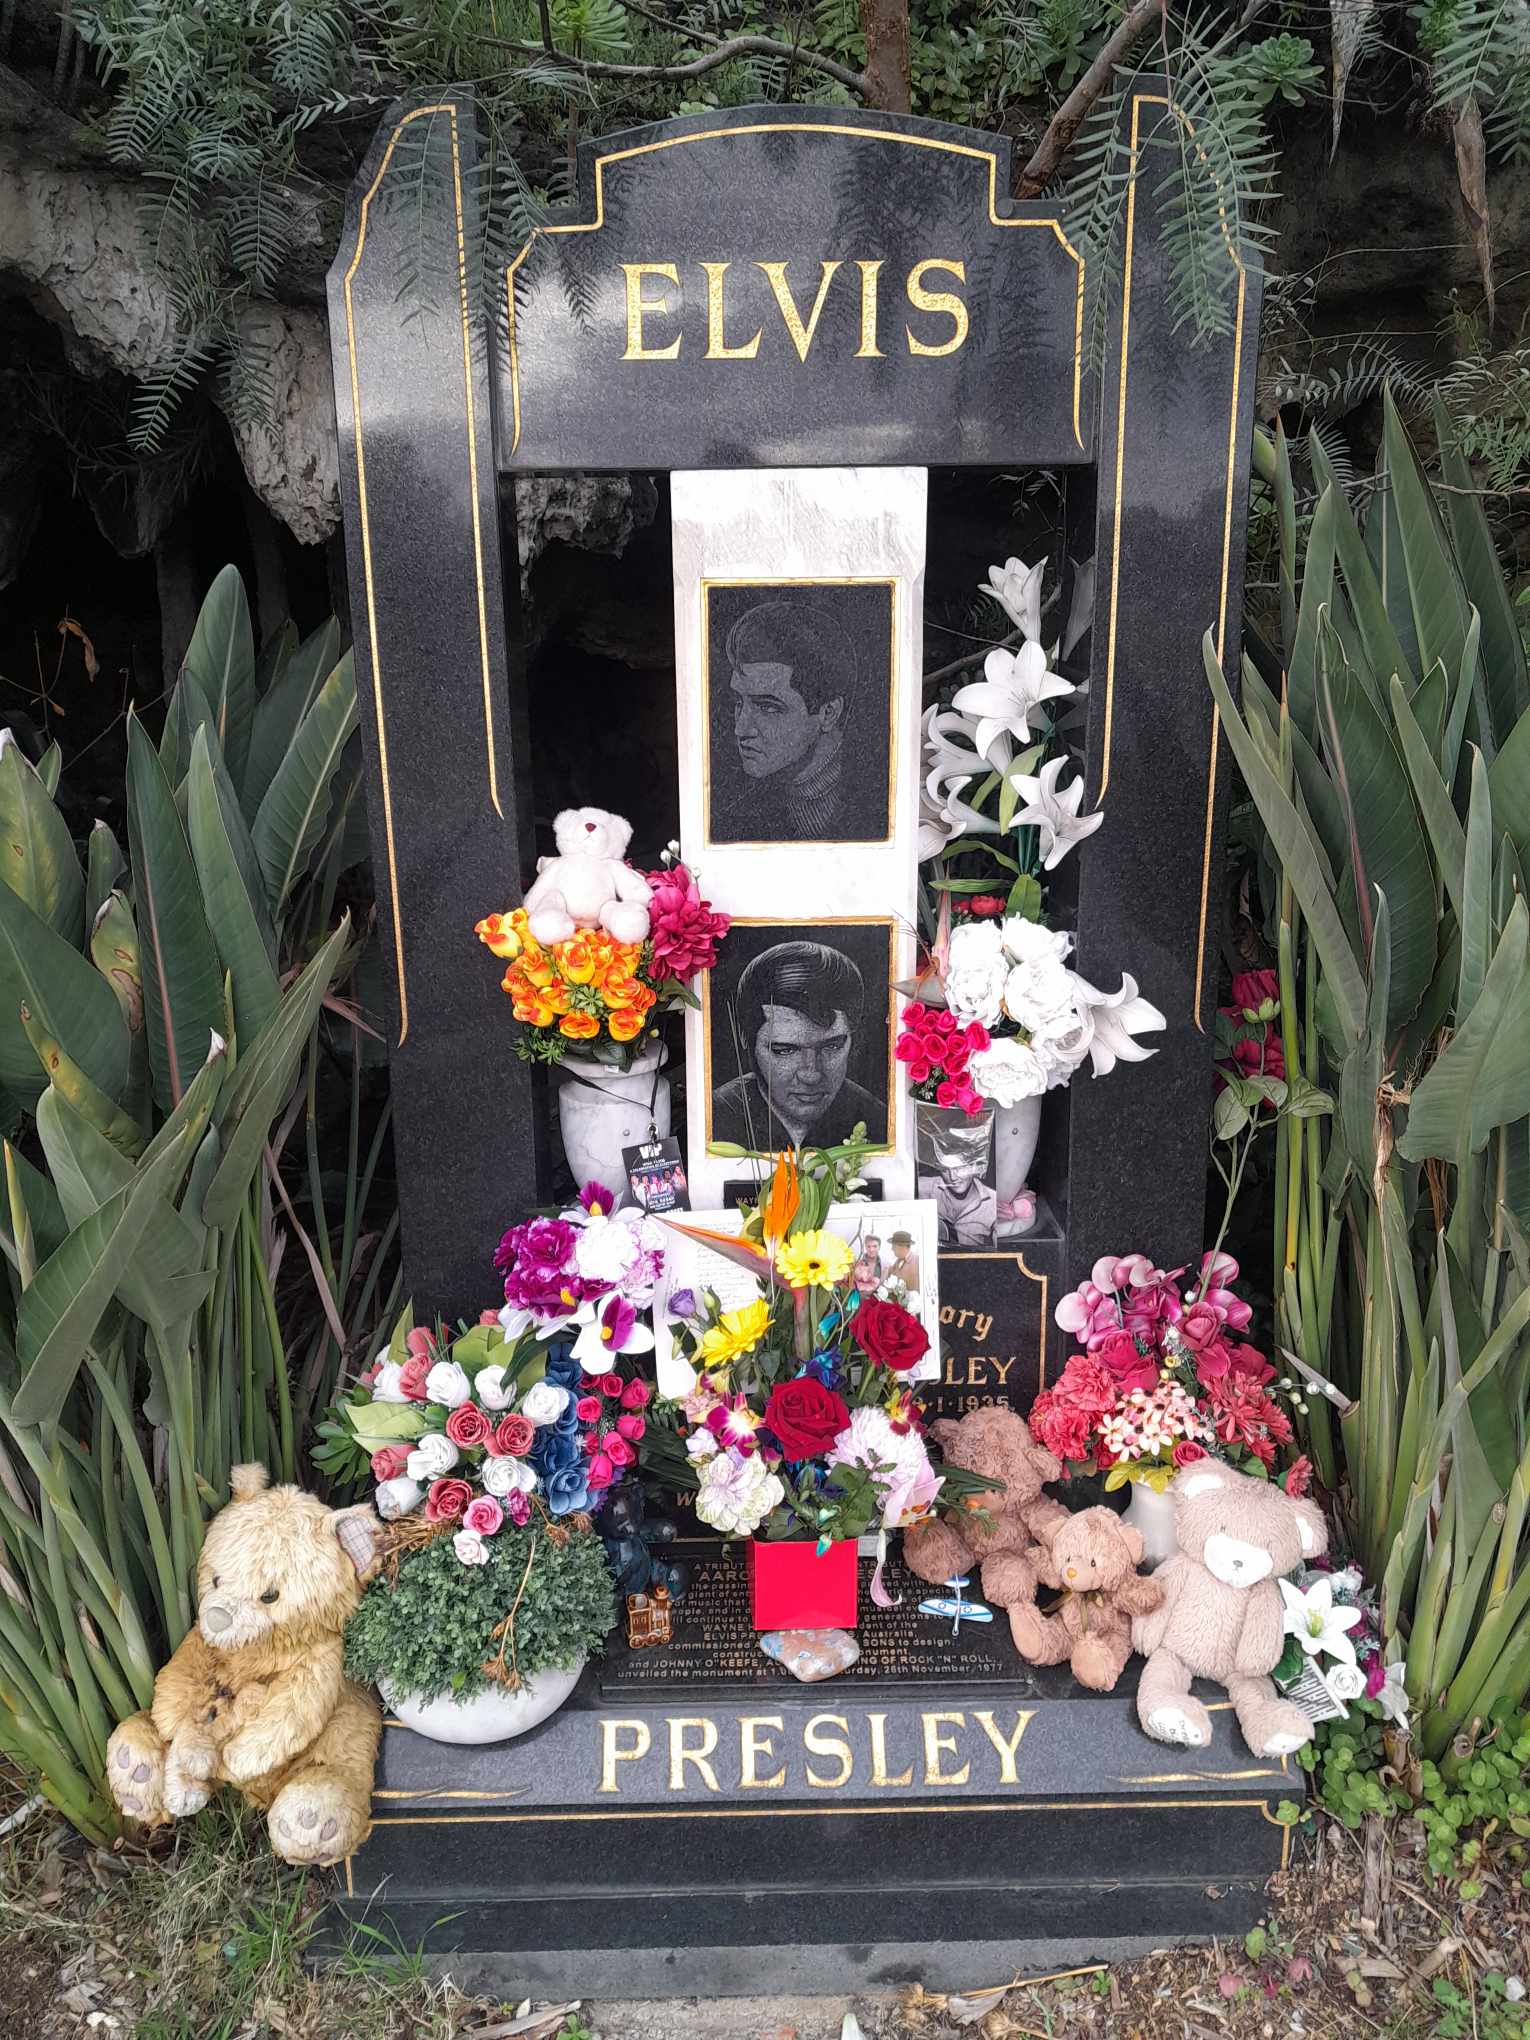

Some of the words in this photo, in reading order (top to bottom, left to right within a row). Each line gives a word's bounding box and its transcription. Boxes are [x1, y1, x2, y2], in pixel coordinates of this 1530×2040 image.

[617, 258, 969, 363] ELVIS
[940, 1305, 993, 1341] ory
[938, 1356, 1017, 1385] LEY
[704, 1562, 745, 1570] TRIBUT
[699, 1570, 751, 1581] AARO
[672, 1608, 705, 1616] eople,
[686, 1616, 735, 1624] continue
[864, 1613, 930, 1622] generations
[858, 1621, 883, 1629] dent
[887, 1621, 898, 1629] of
[900, 1620, 918, 1628] the
[704, 1632, 738, 1640] ELVIS
[863, 1630, 918, 1639] Australia,
[668, 1641, 750, 1650] commissioned
[629, 1660, 649, 1668] and
[653, 1660, 701, 1668] JOHNNY
[858, 1656, 877, 1665] ING
[881, 1657, 896, 1665] OF
[900, 1655, 935, 1664] ROCK
[618, 1670, 667, 1678] unveiled
[671, 1669, 688, 1677] the
[692, 1669, 752, 1678] monument
[756, 1668, 767, 1676] at
[841, 1666, 880, 1676] urday,
[978, 1663, 1004, 1672] 1977
[597, 1710, 1039, 1792] PRESLEY
